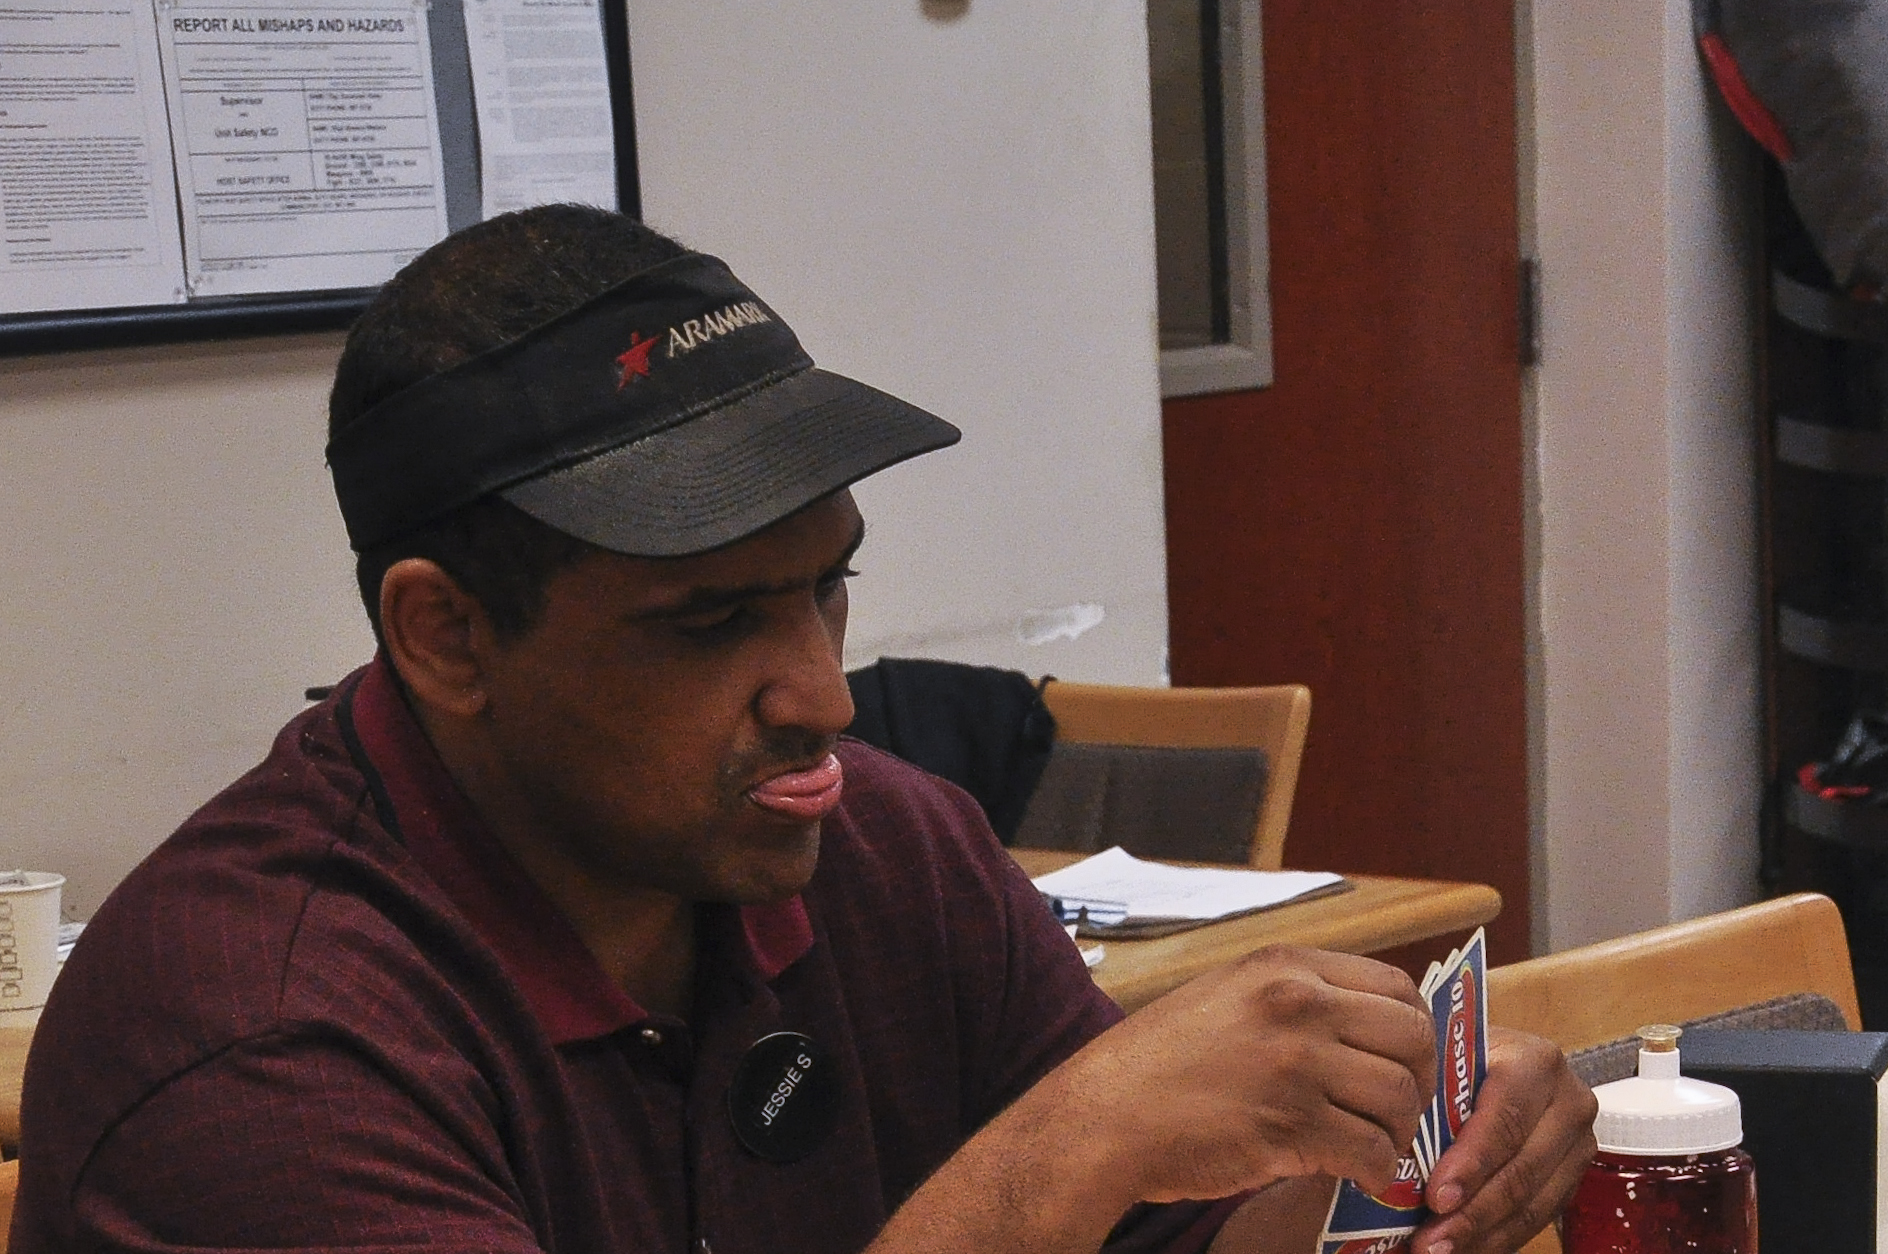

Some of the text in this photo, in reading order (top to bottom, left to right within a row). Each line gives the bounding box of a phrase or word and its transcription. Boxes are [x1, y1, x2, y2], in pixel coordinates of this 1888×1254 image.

[173, 18, 405, 33] REPORT ALL MISHAPS AND HAZARDS
[667, 300, 772, 359] ARAMARK
[1451, 980, 1464, 1014] 10
[761, 1053, 812, 1126] JESSIE S
